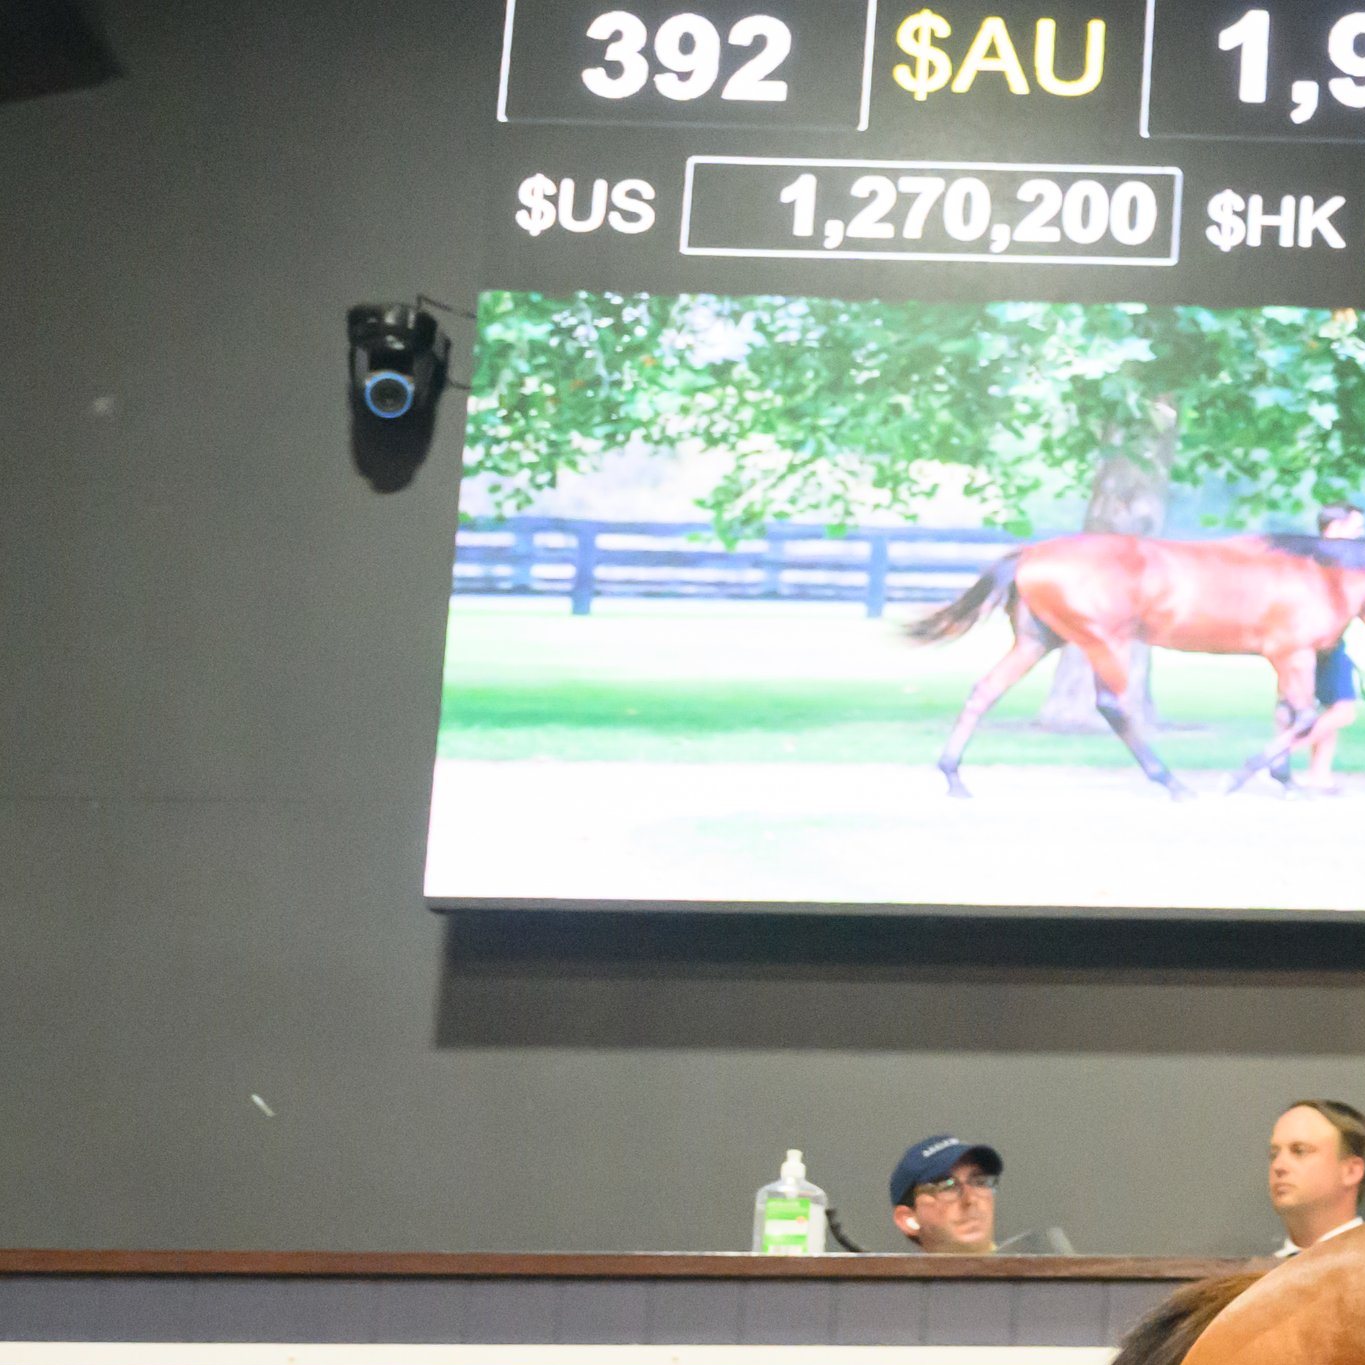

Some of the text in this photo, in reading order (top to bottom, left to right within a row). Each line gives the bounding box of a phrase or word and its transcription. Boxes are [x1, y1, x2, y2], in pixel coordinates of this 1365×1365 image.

[581, 10, 792, 101] 392
[893, 9, 1105, 100] $AU
[515, 173, 656, 236] $US
[779, 174, 1157, 252] 1,270,200
[1205, 188, 1346, 252] $HK
